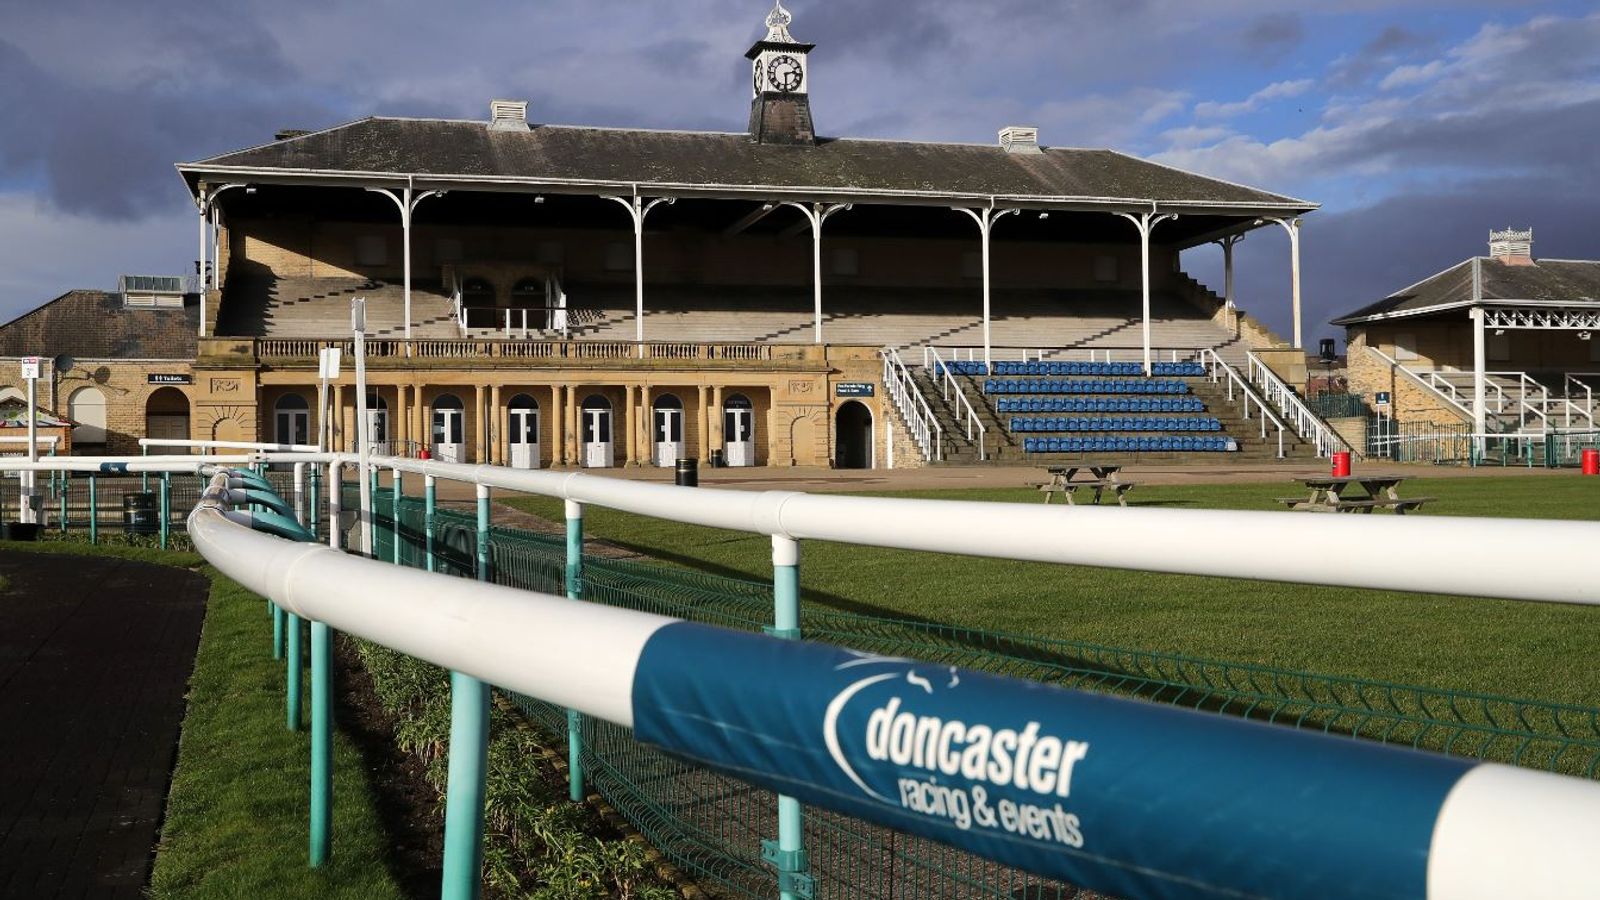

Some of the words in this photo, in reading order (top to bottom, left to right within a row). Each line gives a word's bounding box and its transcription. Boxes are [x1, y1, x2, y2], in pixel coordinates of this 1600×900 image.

[866, 696, 1089, 797] doncaster
[898, 776, 971, 830] racing
[972, 785, 999, 828] &
[999, 799, 1084, 848] events
